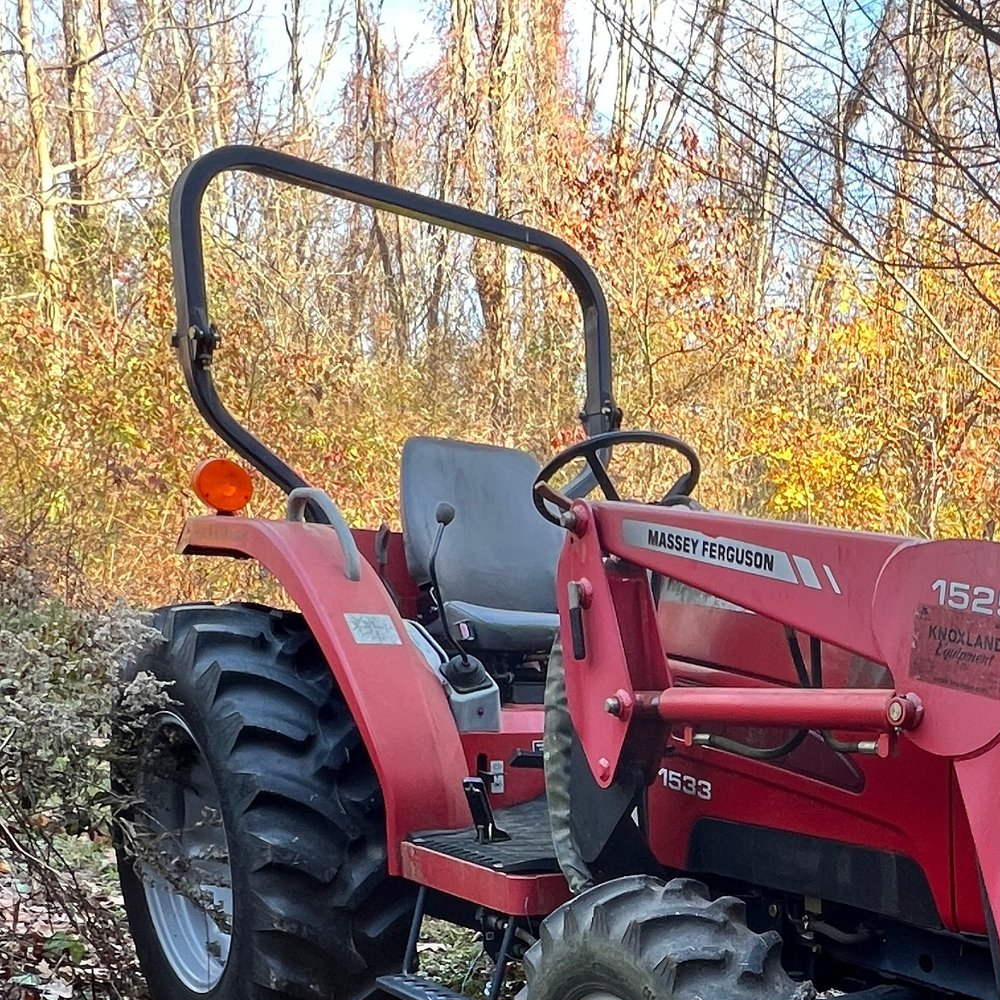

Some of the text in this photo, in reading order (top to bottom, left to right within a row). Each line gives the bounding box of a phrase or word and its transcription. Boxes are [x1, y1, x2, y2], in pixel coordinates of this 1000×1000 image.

[648, 529, 774, 572] MASSEY FERGUSON
[935, 642, 995, 667] Equipment
[658, 767, 712, 800] 1533
